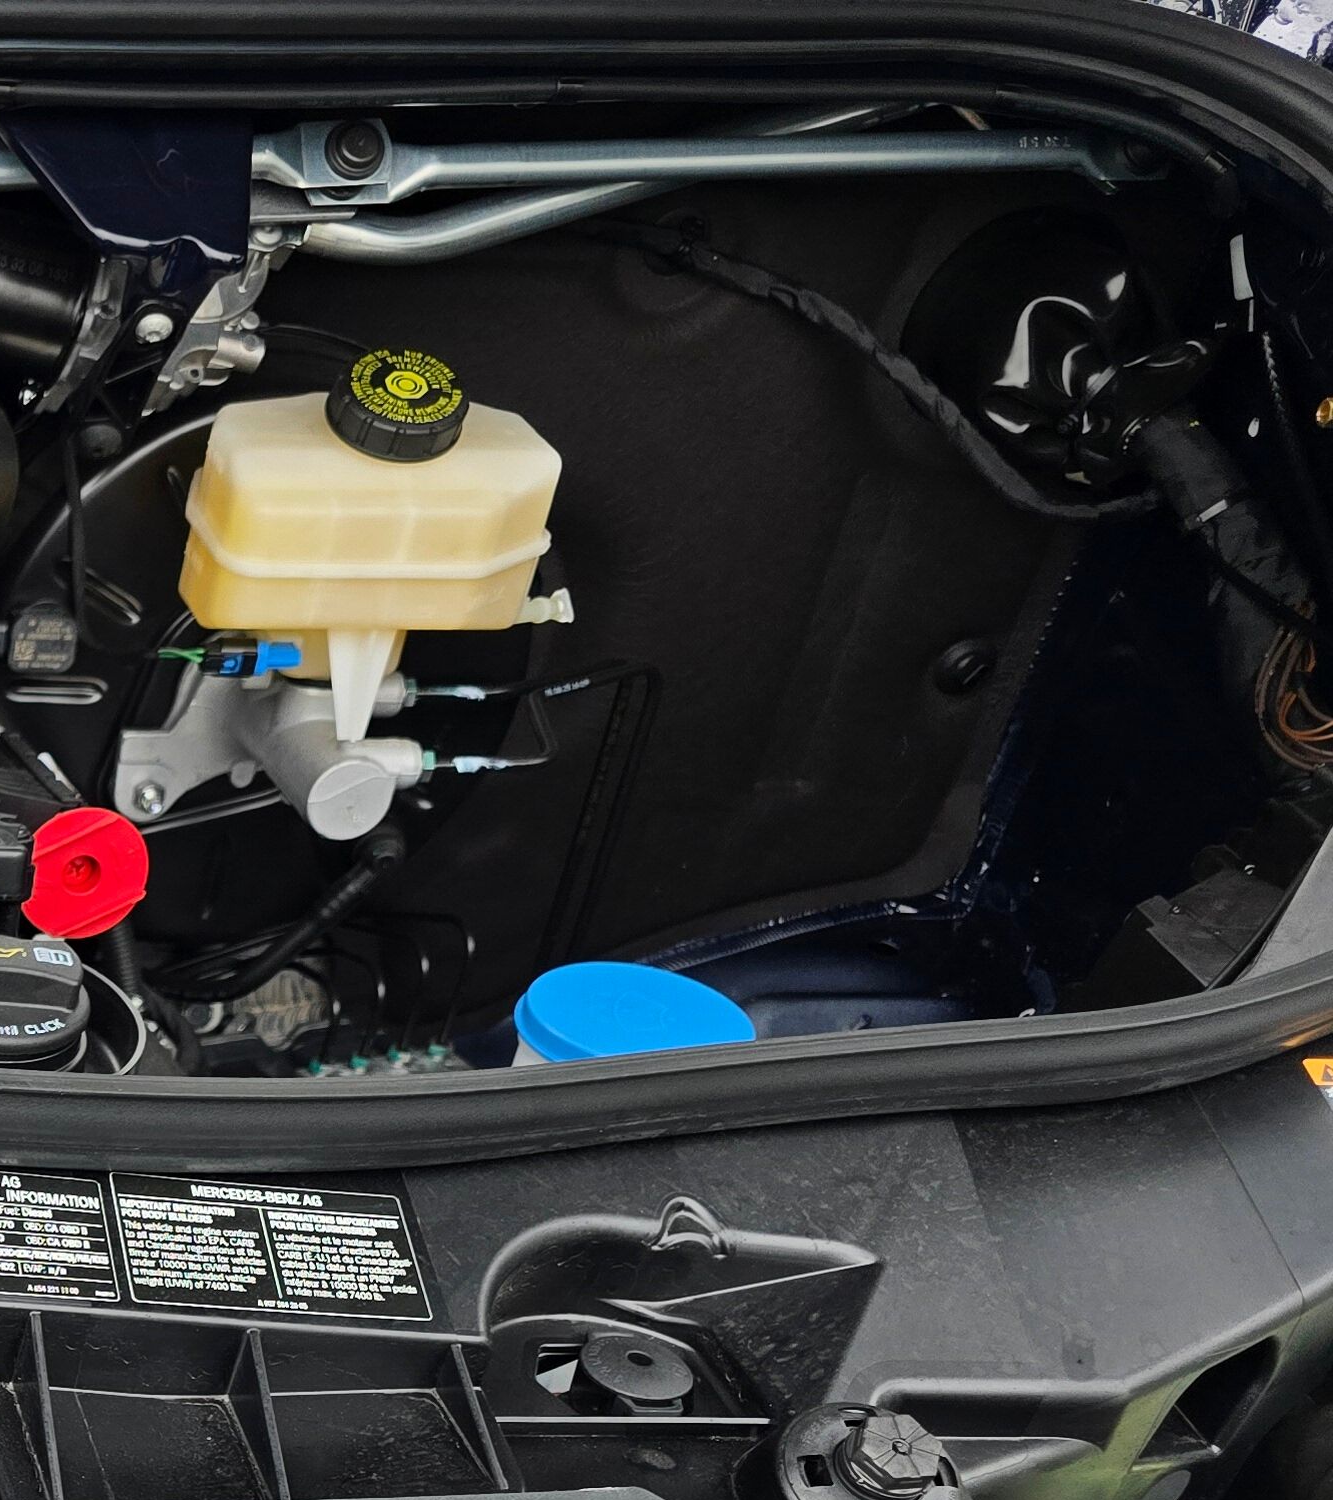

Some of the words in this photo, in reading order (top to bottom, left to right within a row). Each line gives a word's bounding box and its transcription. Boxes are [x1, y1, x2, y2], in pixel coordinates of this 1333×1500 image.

[23, 1018, 66, 1035] CLICK
[1, 1176, 21, 1188] AG
[5, 1189, 100, 1209] INFORMATION
[191, 1185, 301, 1205] MERCEDES-BENZ
[303, 1195, 323, 1207] AG
[21, 1207, 53, 1219] Diesel
[121, 1208, 141, 1218] FOR
[123, 1220, 142, 1229] This
[143, 1223, 173, 1233] vehicle
[175, 1225, 191, 1234] and
[193, 1227, 221, 1237] engine
[223, 1228, 259, 1239] conform
[269, 1220, 296, 1230] POUR
[297, 1223, 314, 1232] LES
[125, 1229, 135, 1238] to
[149, 1231, 192, 1244] applicable
[193, 1236, 207, 1244] US
[230, 1239, 255, 1248] CARB
[273, 1232, 284, 1241] Le
[342, 1238, 373, 1247] moteur
[374, 1240, 394, 1249] sont
[127, 1240, 144, 1248] and
[145, 1240, 186, 1252] Canadian
[187, 1243, 235, 1256] regulations
[247, 1248, 262, 1257] the
[275, 1242, 321, 1253] conformes
[322, 1245, 338, 1254] aux
[339, 1246, 379, 1257] directives
[380, 1249, 399, 1258] EPA
[129, 1248, 149, 1257] time
[150, 1250, 160, 1258] of
[161, 1251, 215, 1263] manufacture
[216, 1255, 230, 1264] for
[231, 1256, 267, 1266] vehicles
[277, 1252, 302, 1260] CARB
[354, 1256, 388, 1267] Canada
[130, 1258, 156, 1267] under
[159, 1260, 187, 1270] 10000
[232, 1266, 249, 1274] and
[359, 1266, 406, 1277] production
[140, 1268, 183, 1279] maximum
[184, 1271, 224, 1281] unloaded
[225, 1274, 256, 1284] vehicle
[133, 1277, 164, 1288] weight
[165, 1278, 193, 1290] (UVW)
[194, 1281, 204, 1289] of
[205, 1281, 229, 1291] 7400
[230, 1283, 247, 1292] lbs.
[330, 1281, 357, 1291] 10000
[349, 1291, 372, 1301] 7400
